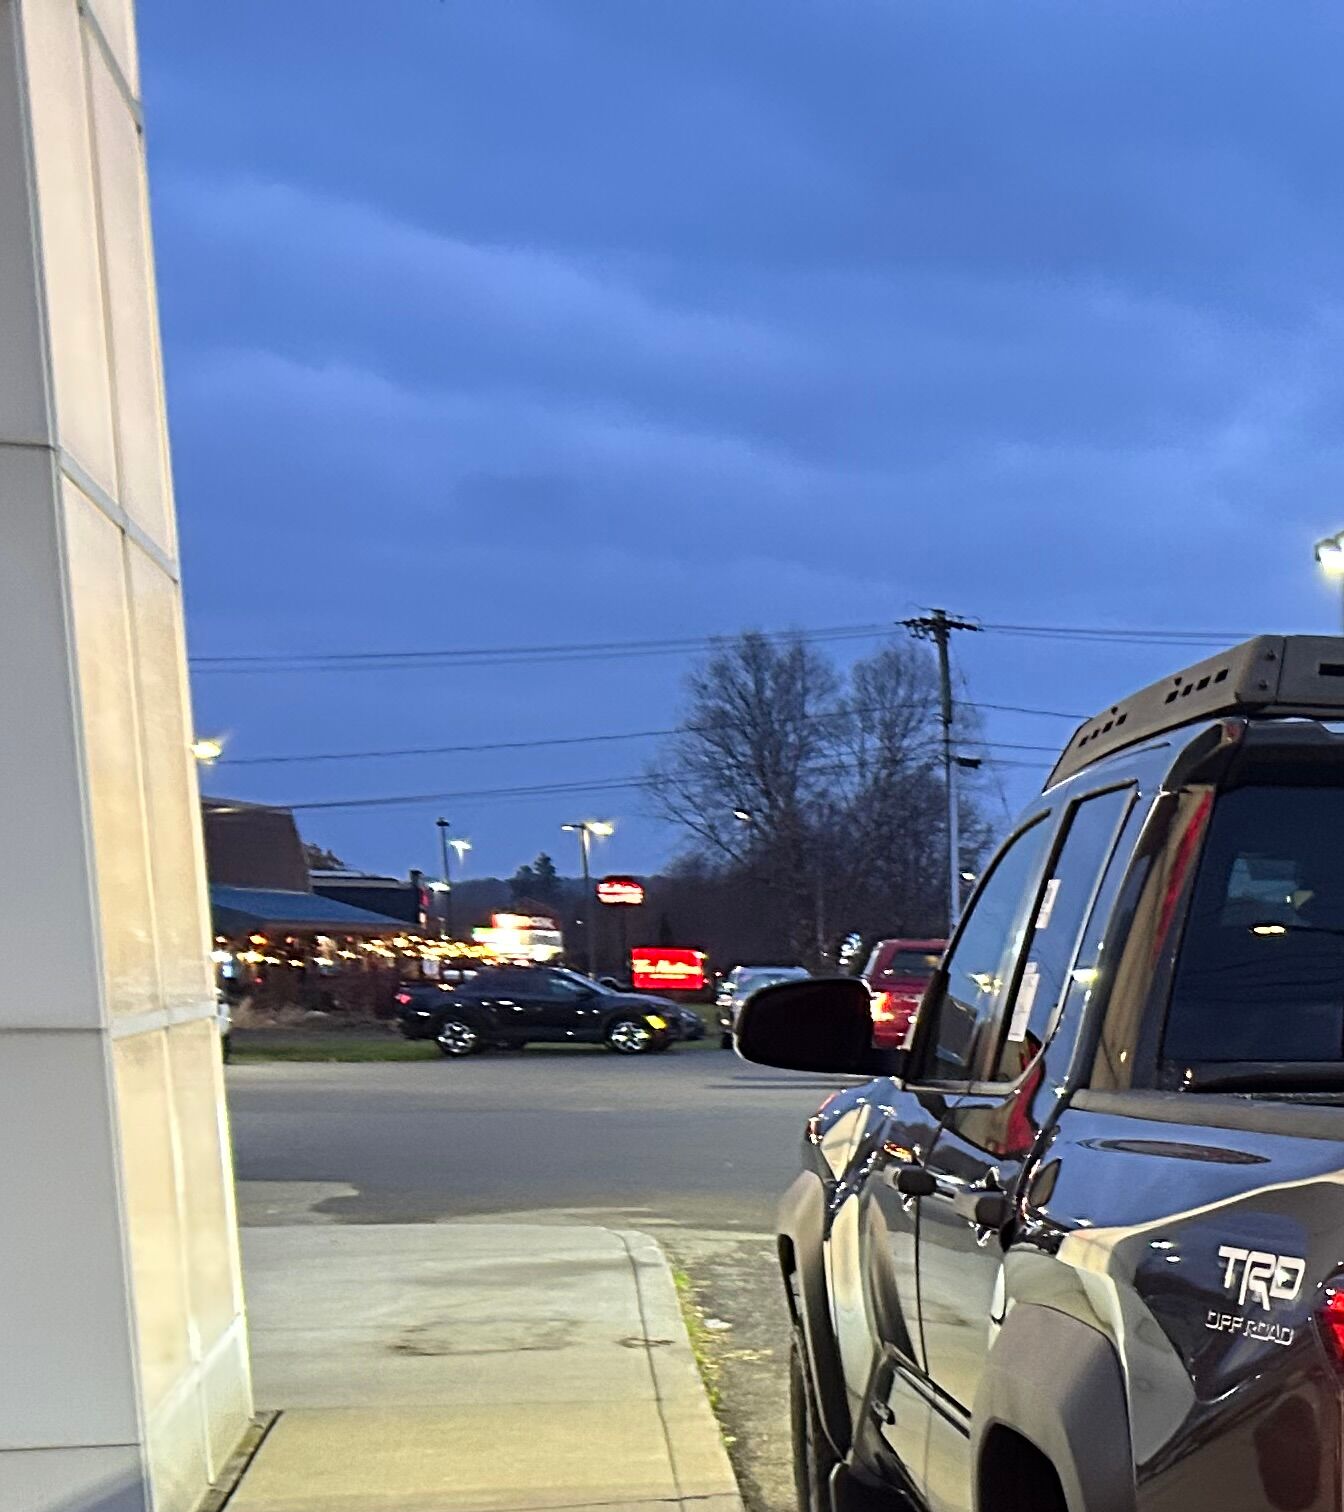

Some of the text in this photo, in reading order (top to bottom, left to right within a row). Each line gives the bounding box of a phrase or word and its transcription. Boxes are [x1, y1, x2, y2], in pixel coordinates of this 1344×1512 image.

[1218, 1245, 1306, 1311] TRD
[1204, 1309, 1295, 1347] OFF ROAD
